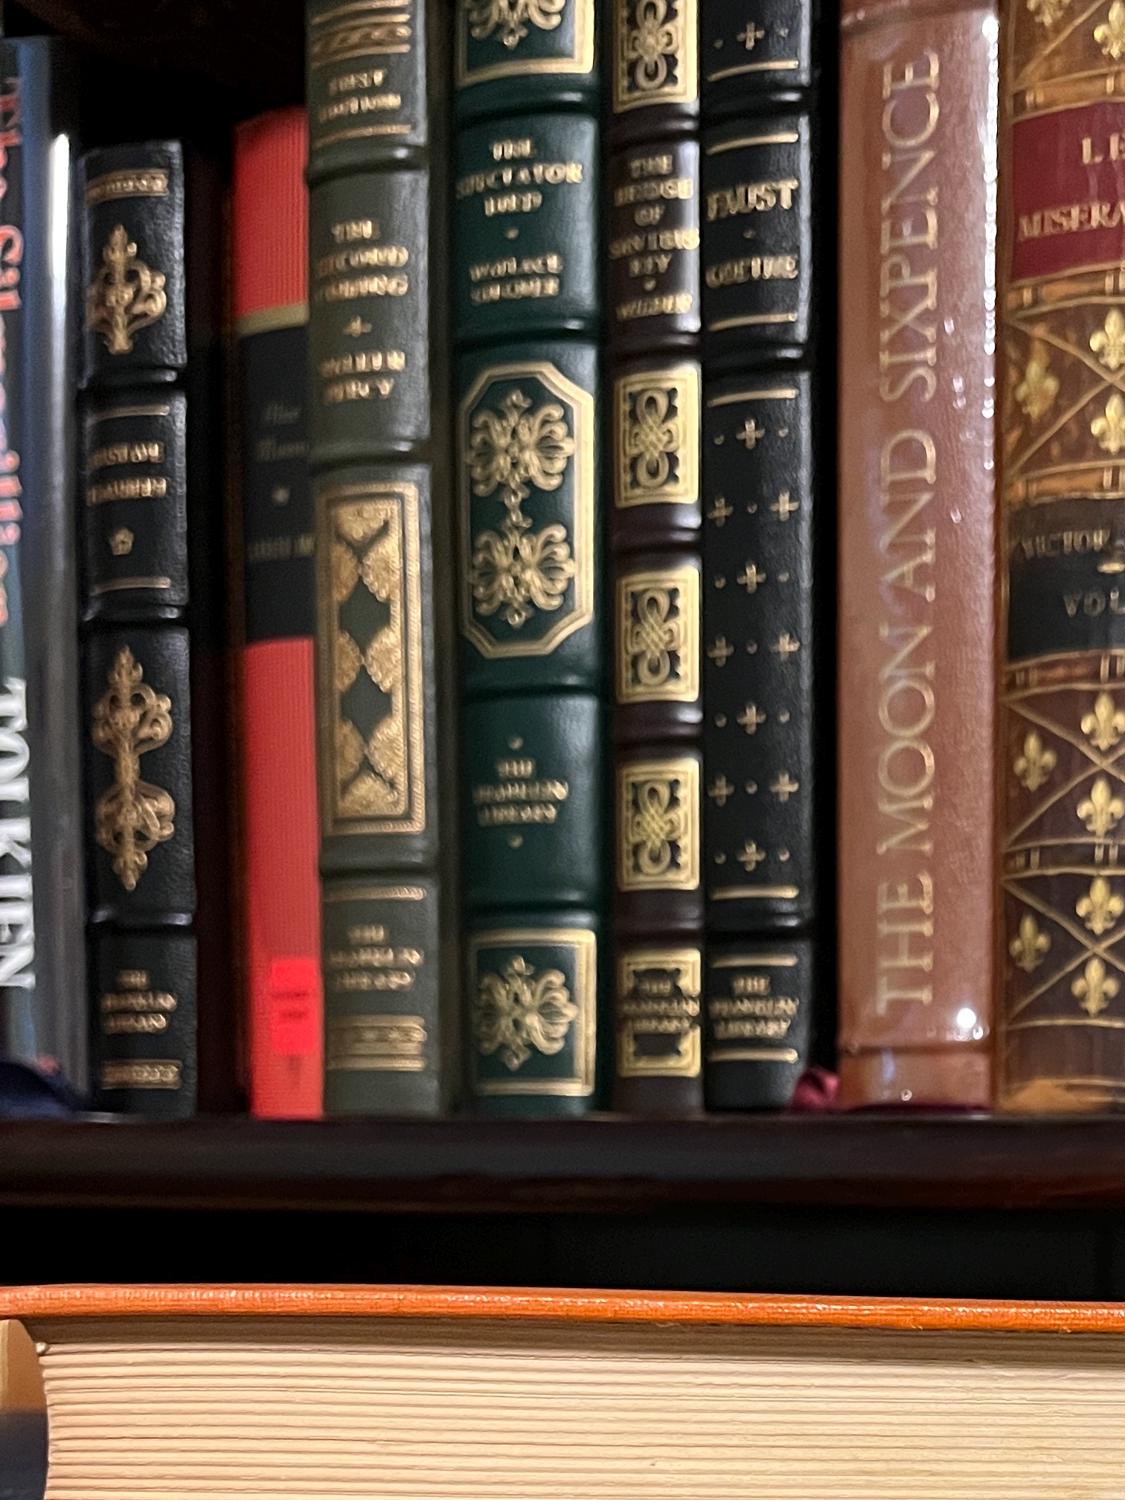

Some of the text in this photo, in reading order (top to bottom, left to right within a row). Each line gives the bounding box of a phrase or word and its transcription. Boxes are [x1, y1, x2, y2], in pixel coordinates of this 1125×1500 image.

[707, 178, 799, 221] FAUST
[876, 50, 940, 1016] THE MOON AND SIXPENCE
